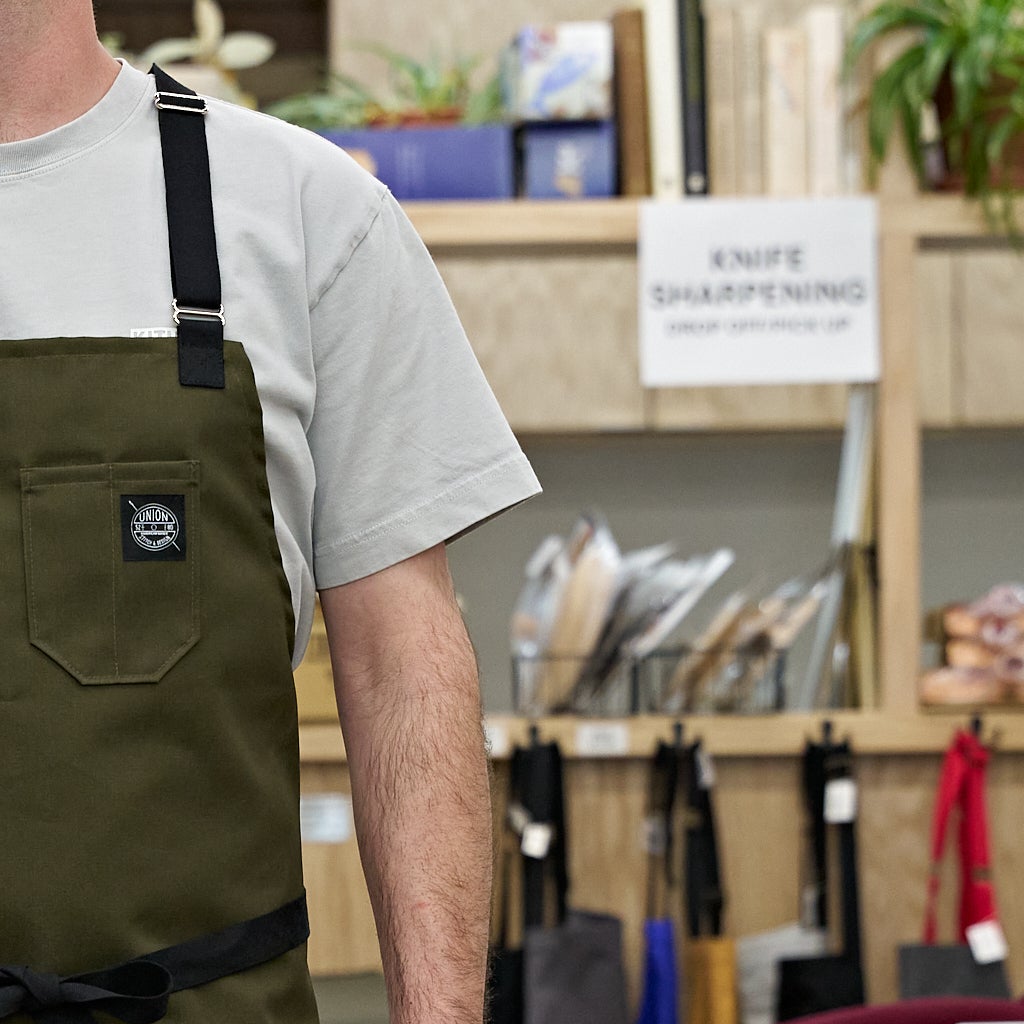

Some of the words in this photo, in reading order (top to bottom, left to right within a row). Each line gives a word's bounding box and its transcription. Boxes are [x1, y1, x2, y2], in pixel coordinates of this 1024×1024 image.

[709, 245, 805, 271] KNIFE
[650, 278, 868, 307] SHARPENING
[139, 509, 168, 521] UNION
